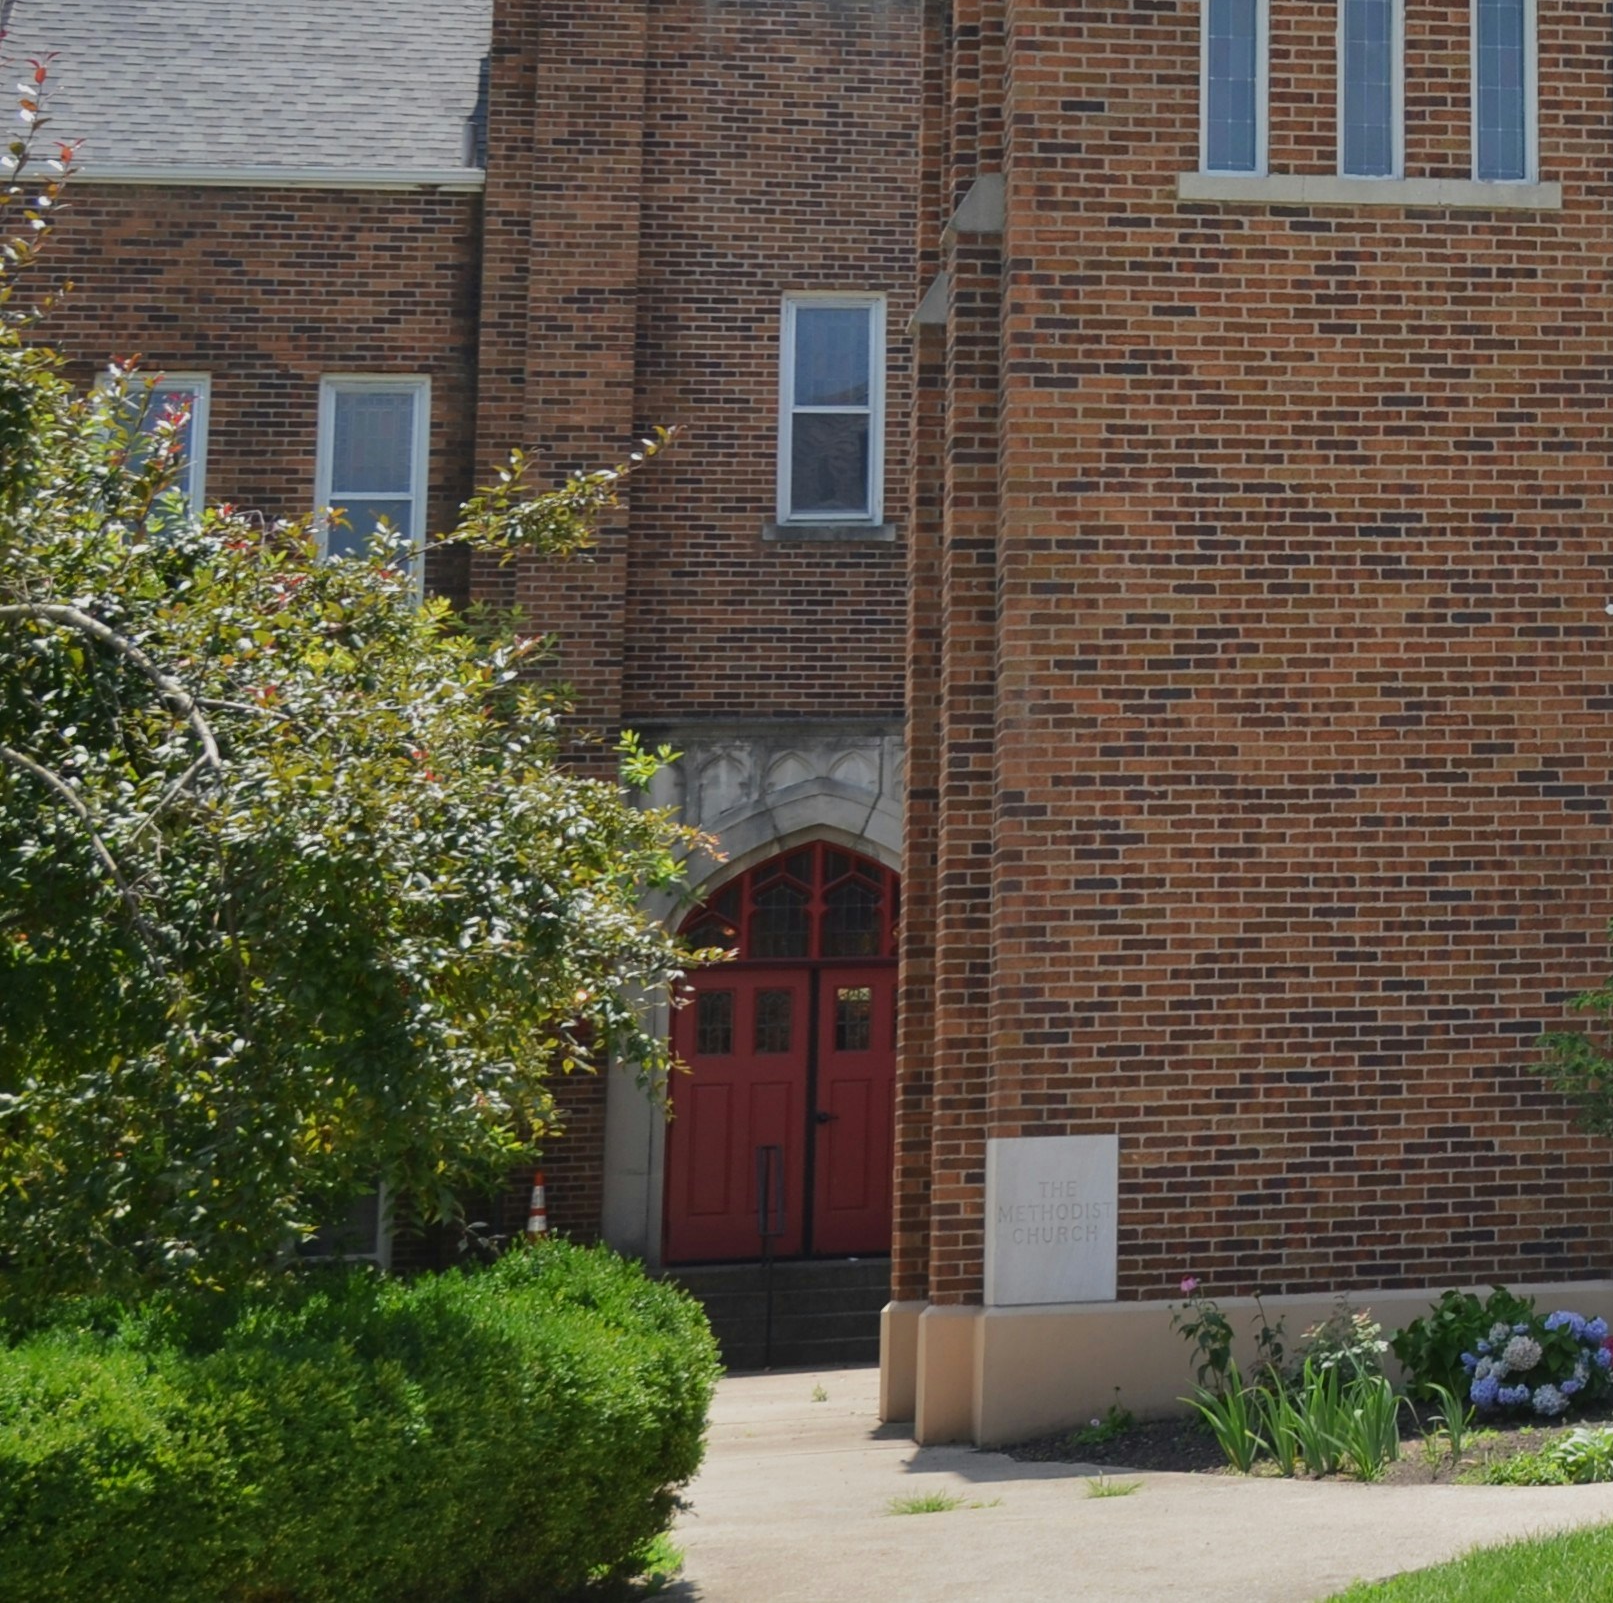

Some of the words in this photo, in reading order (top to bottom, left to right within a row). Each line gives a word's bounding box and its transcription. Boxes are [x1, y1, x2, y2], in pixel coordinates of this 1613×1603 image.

[1038, 1181, 1077, 1197] THE
[999, 1202, 1112, 1222] METHODIST
[1013, 1225, 1098, 1244] CHURCH
